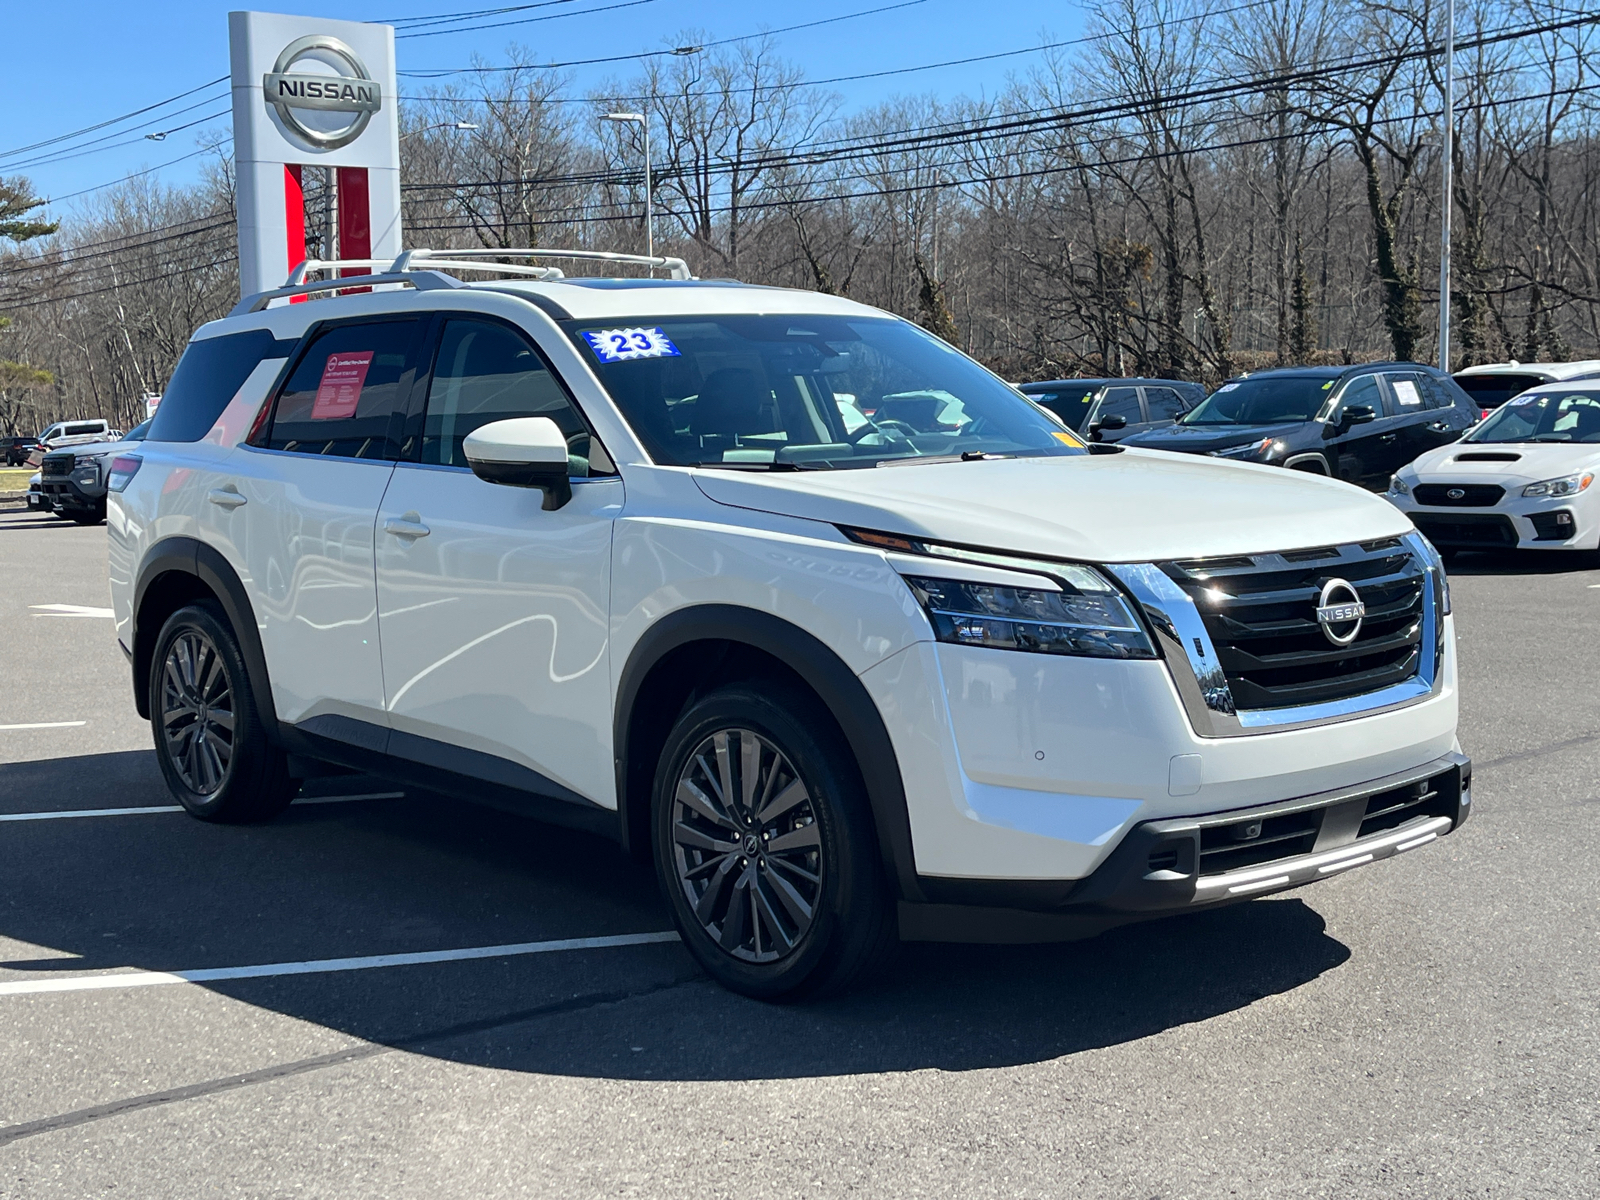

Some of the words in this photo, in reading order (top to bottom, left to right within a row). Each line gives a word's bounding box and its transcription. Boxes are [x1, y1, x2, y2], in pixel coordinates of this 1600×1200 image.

[278, 79, 373, 103] NISSAN
[610, 332, 652, 353] 23
[1318, 605, 1365, 621] NISSAN
